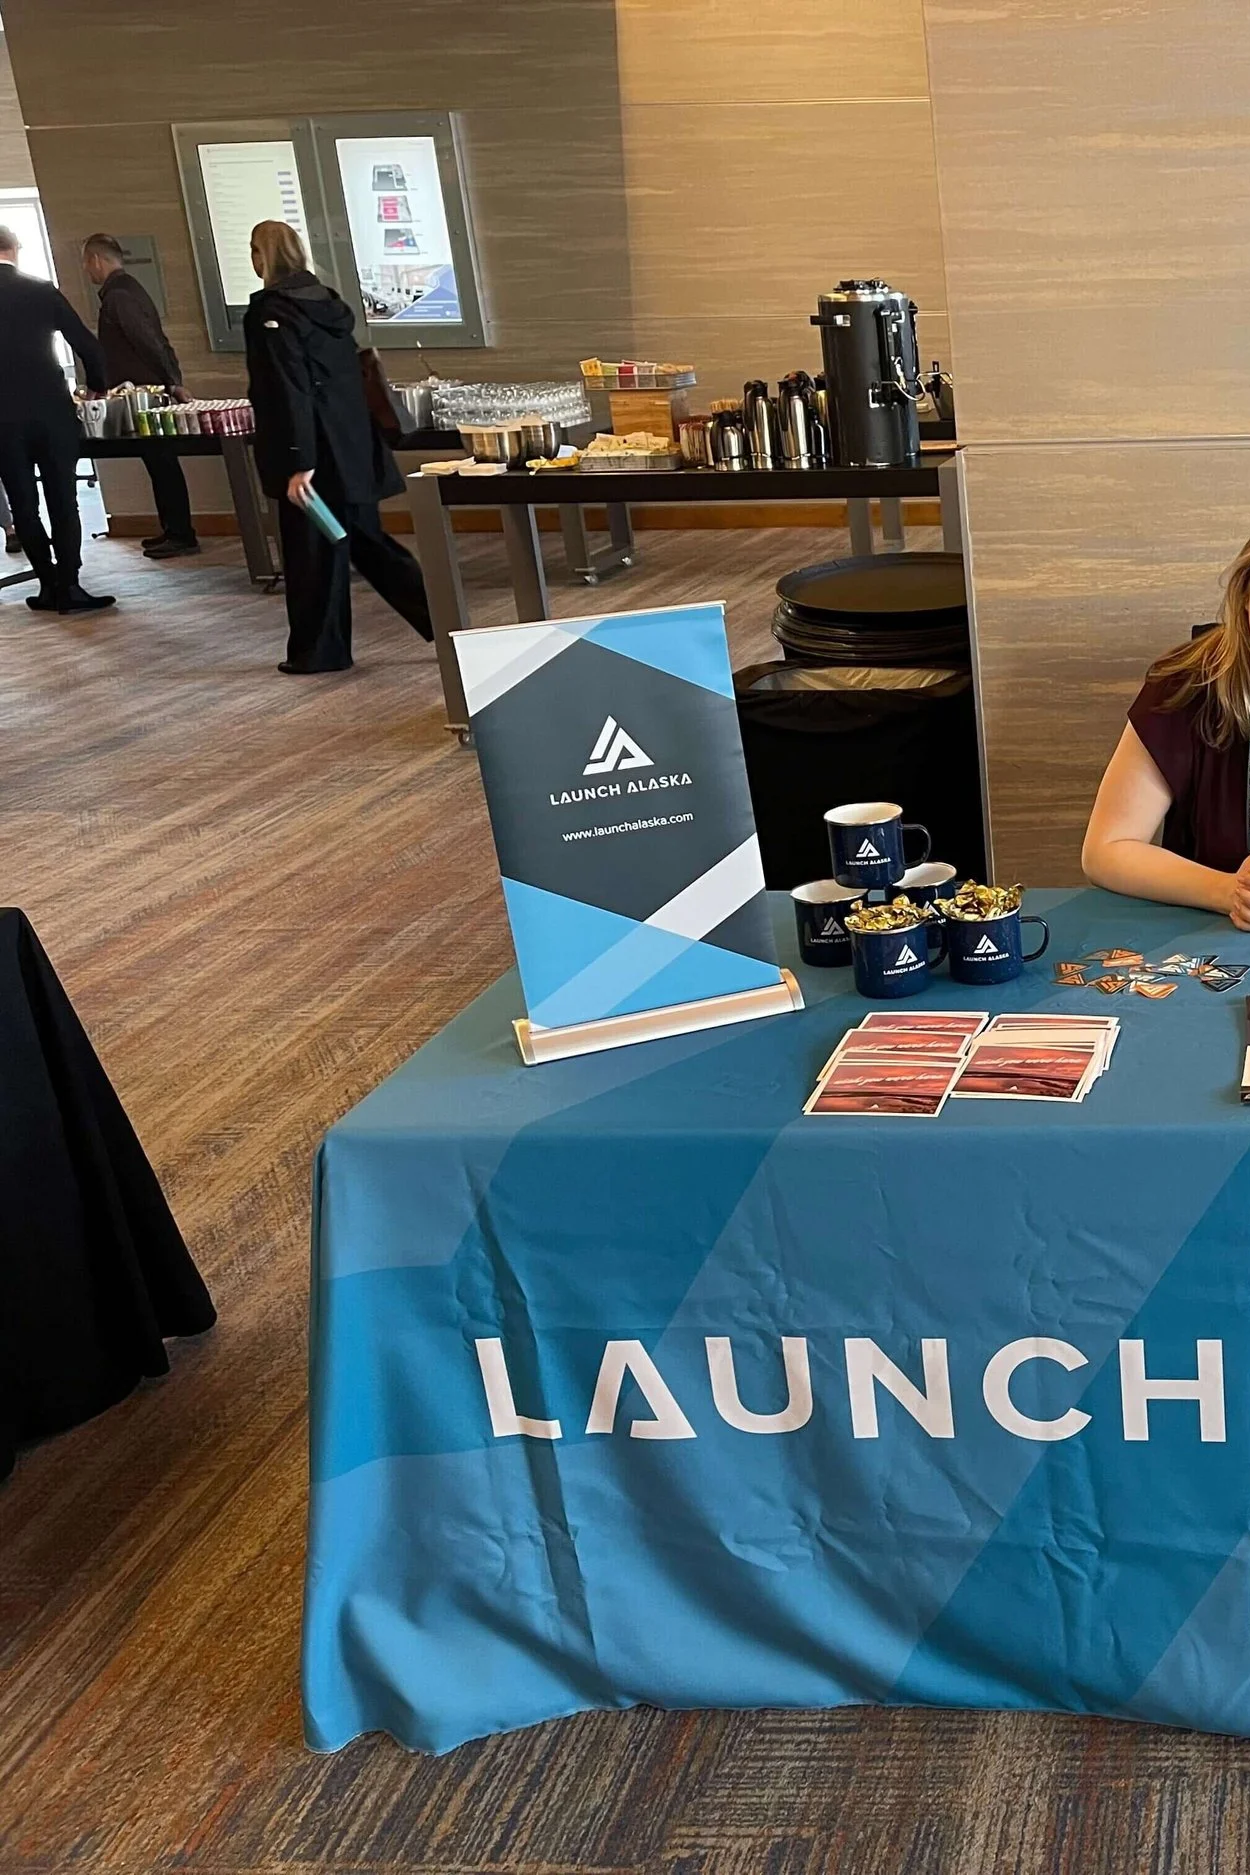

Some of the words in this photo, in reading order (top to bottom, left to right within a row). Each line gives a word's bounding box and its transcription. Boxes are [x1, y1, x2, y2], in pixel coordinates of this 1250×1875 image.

[550, 784, 621, 806] LAUNCH
[627, 773, 693, 794] ALASKA
[562, 812, 694, 842] www.launchalaska.com
[869, 857, 892, 865] ALASKA
[988, 952, 1010, 962] ALASKA
[883, 967, 908, 976] LAUNCH
[474, 1336, 1227, 1443] LAUNCH
